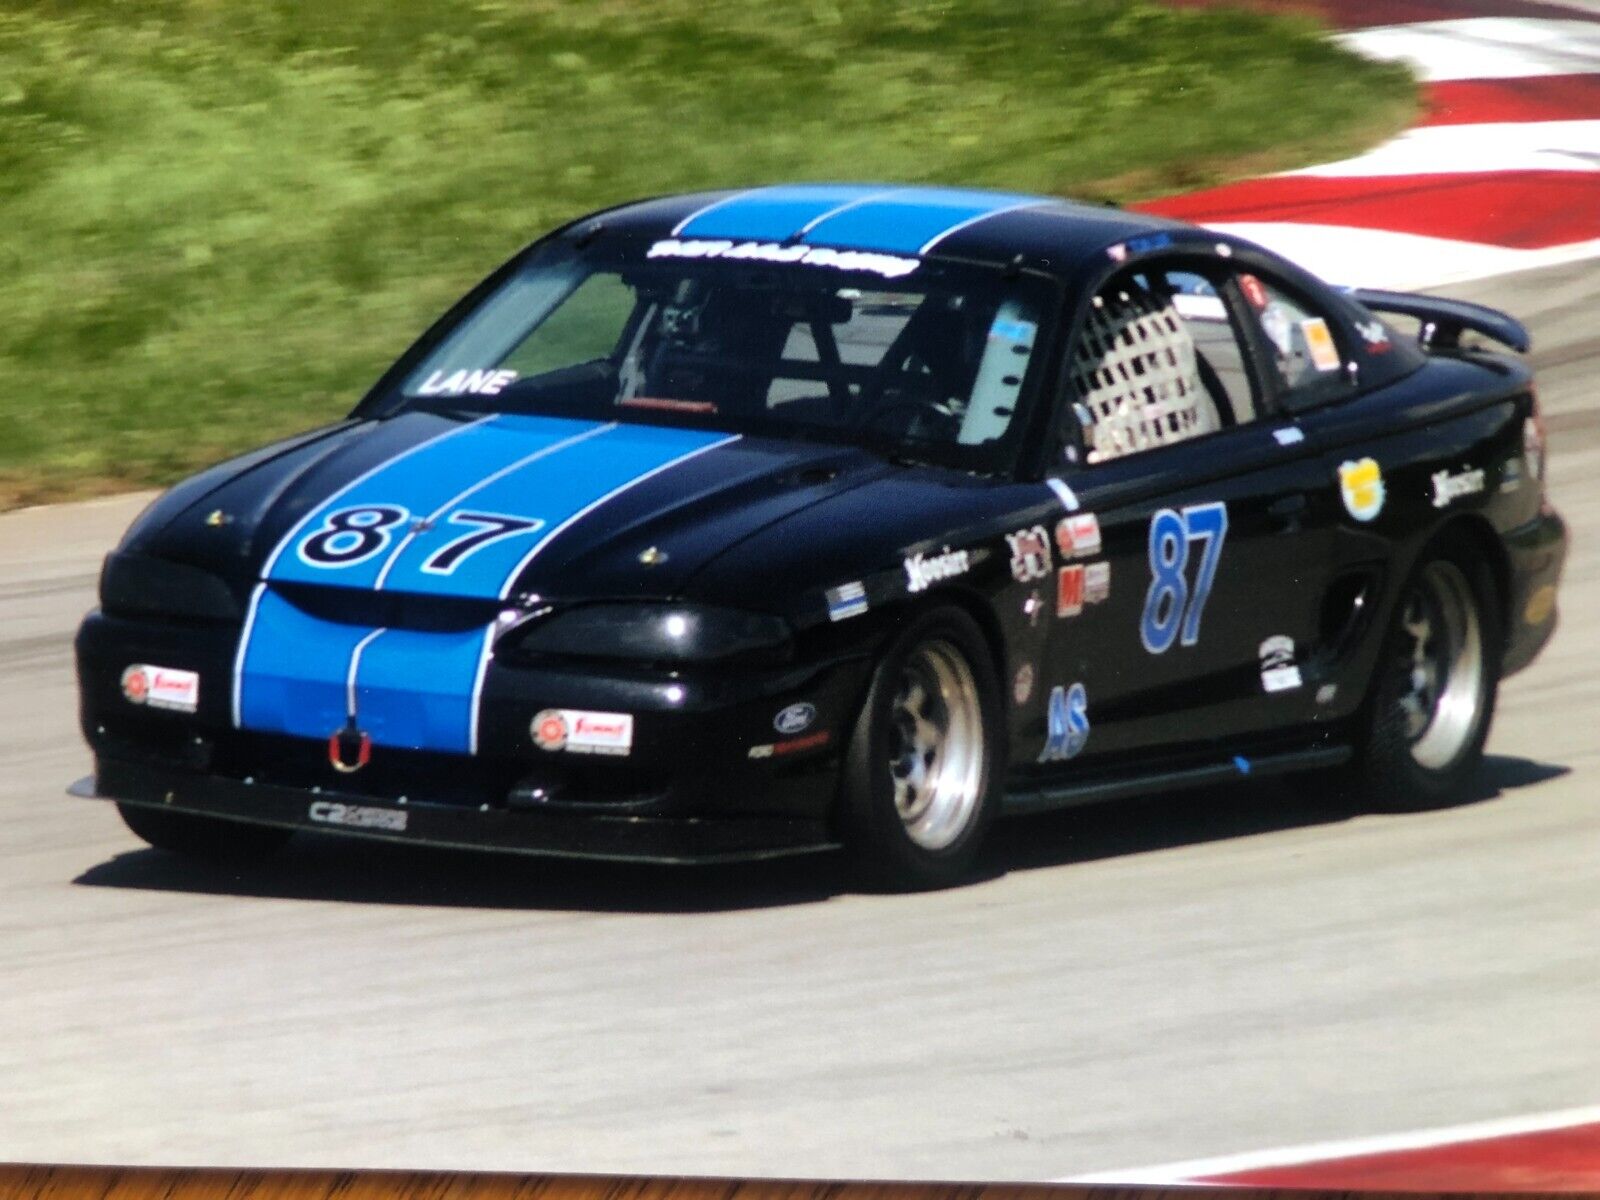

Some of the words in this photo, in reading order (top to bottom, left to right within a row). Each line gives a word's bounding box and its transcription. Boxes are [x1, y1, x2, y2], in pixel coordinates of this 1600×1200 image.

[417, 369, 517, 395] LANE
[296, 503, 546, 575] 87
[1141, 501, 1228, 654] 87
[1036, 682, 1090, 763] AS
